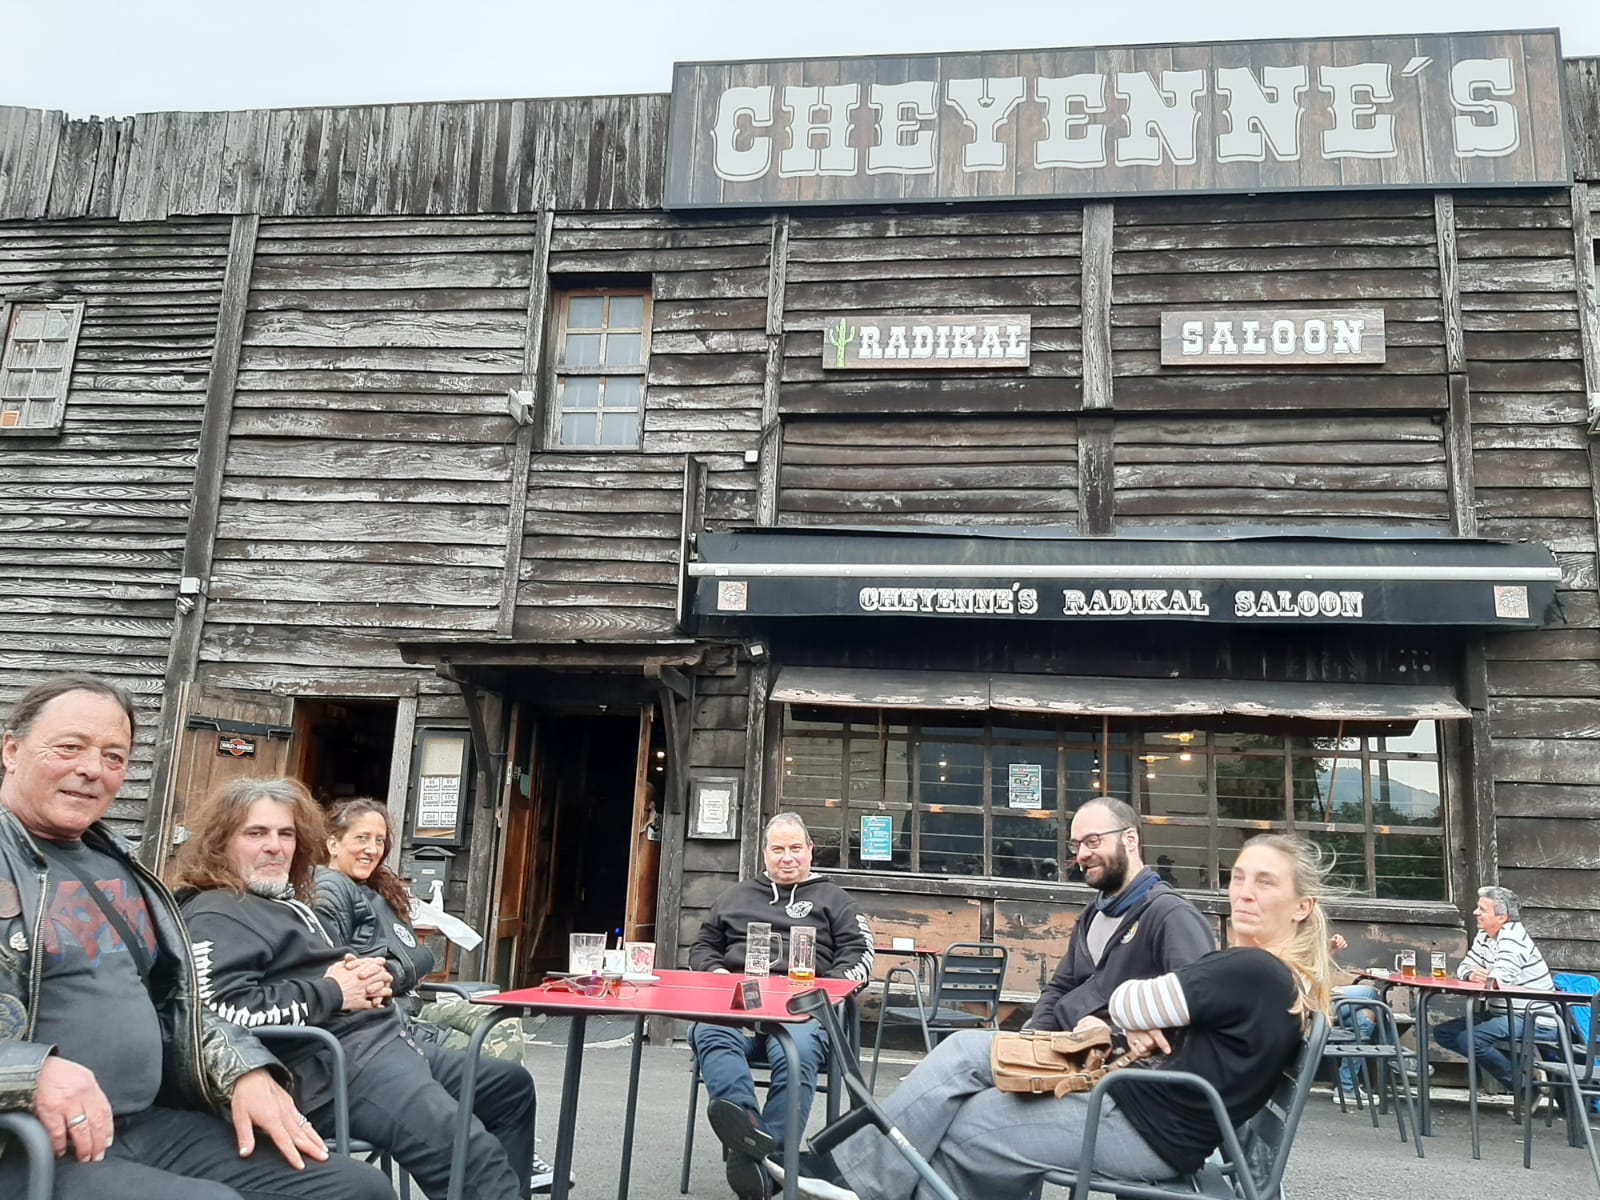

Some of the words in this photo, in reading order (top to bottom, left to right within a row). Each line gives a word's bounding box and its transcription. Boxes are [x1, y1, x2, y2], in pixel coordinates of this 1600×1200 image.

[710, 57, 1520, 182] CHEYENNE'S
[858, 325, 1027, 359] RADIKAL
[1181, 319, 1365, 355] SALOON
[859, 582, 1039, 615] CHEYENNE'S
[1062, 589, 1210, 616] RADIKAL
[1234, 590, 1364, 618] SALOON
